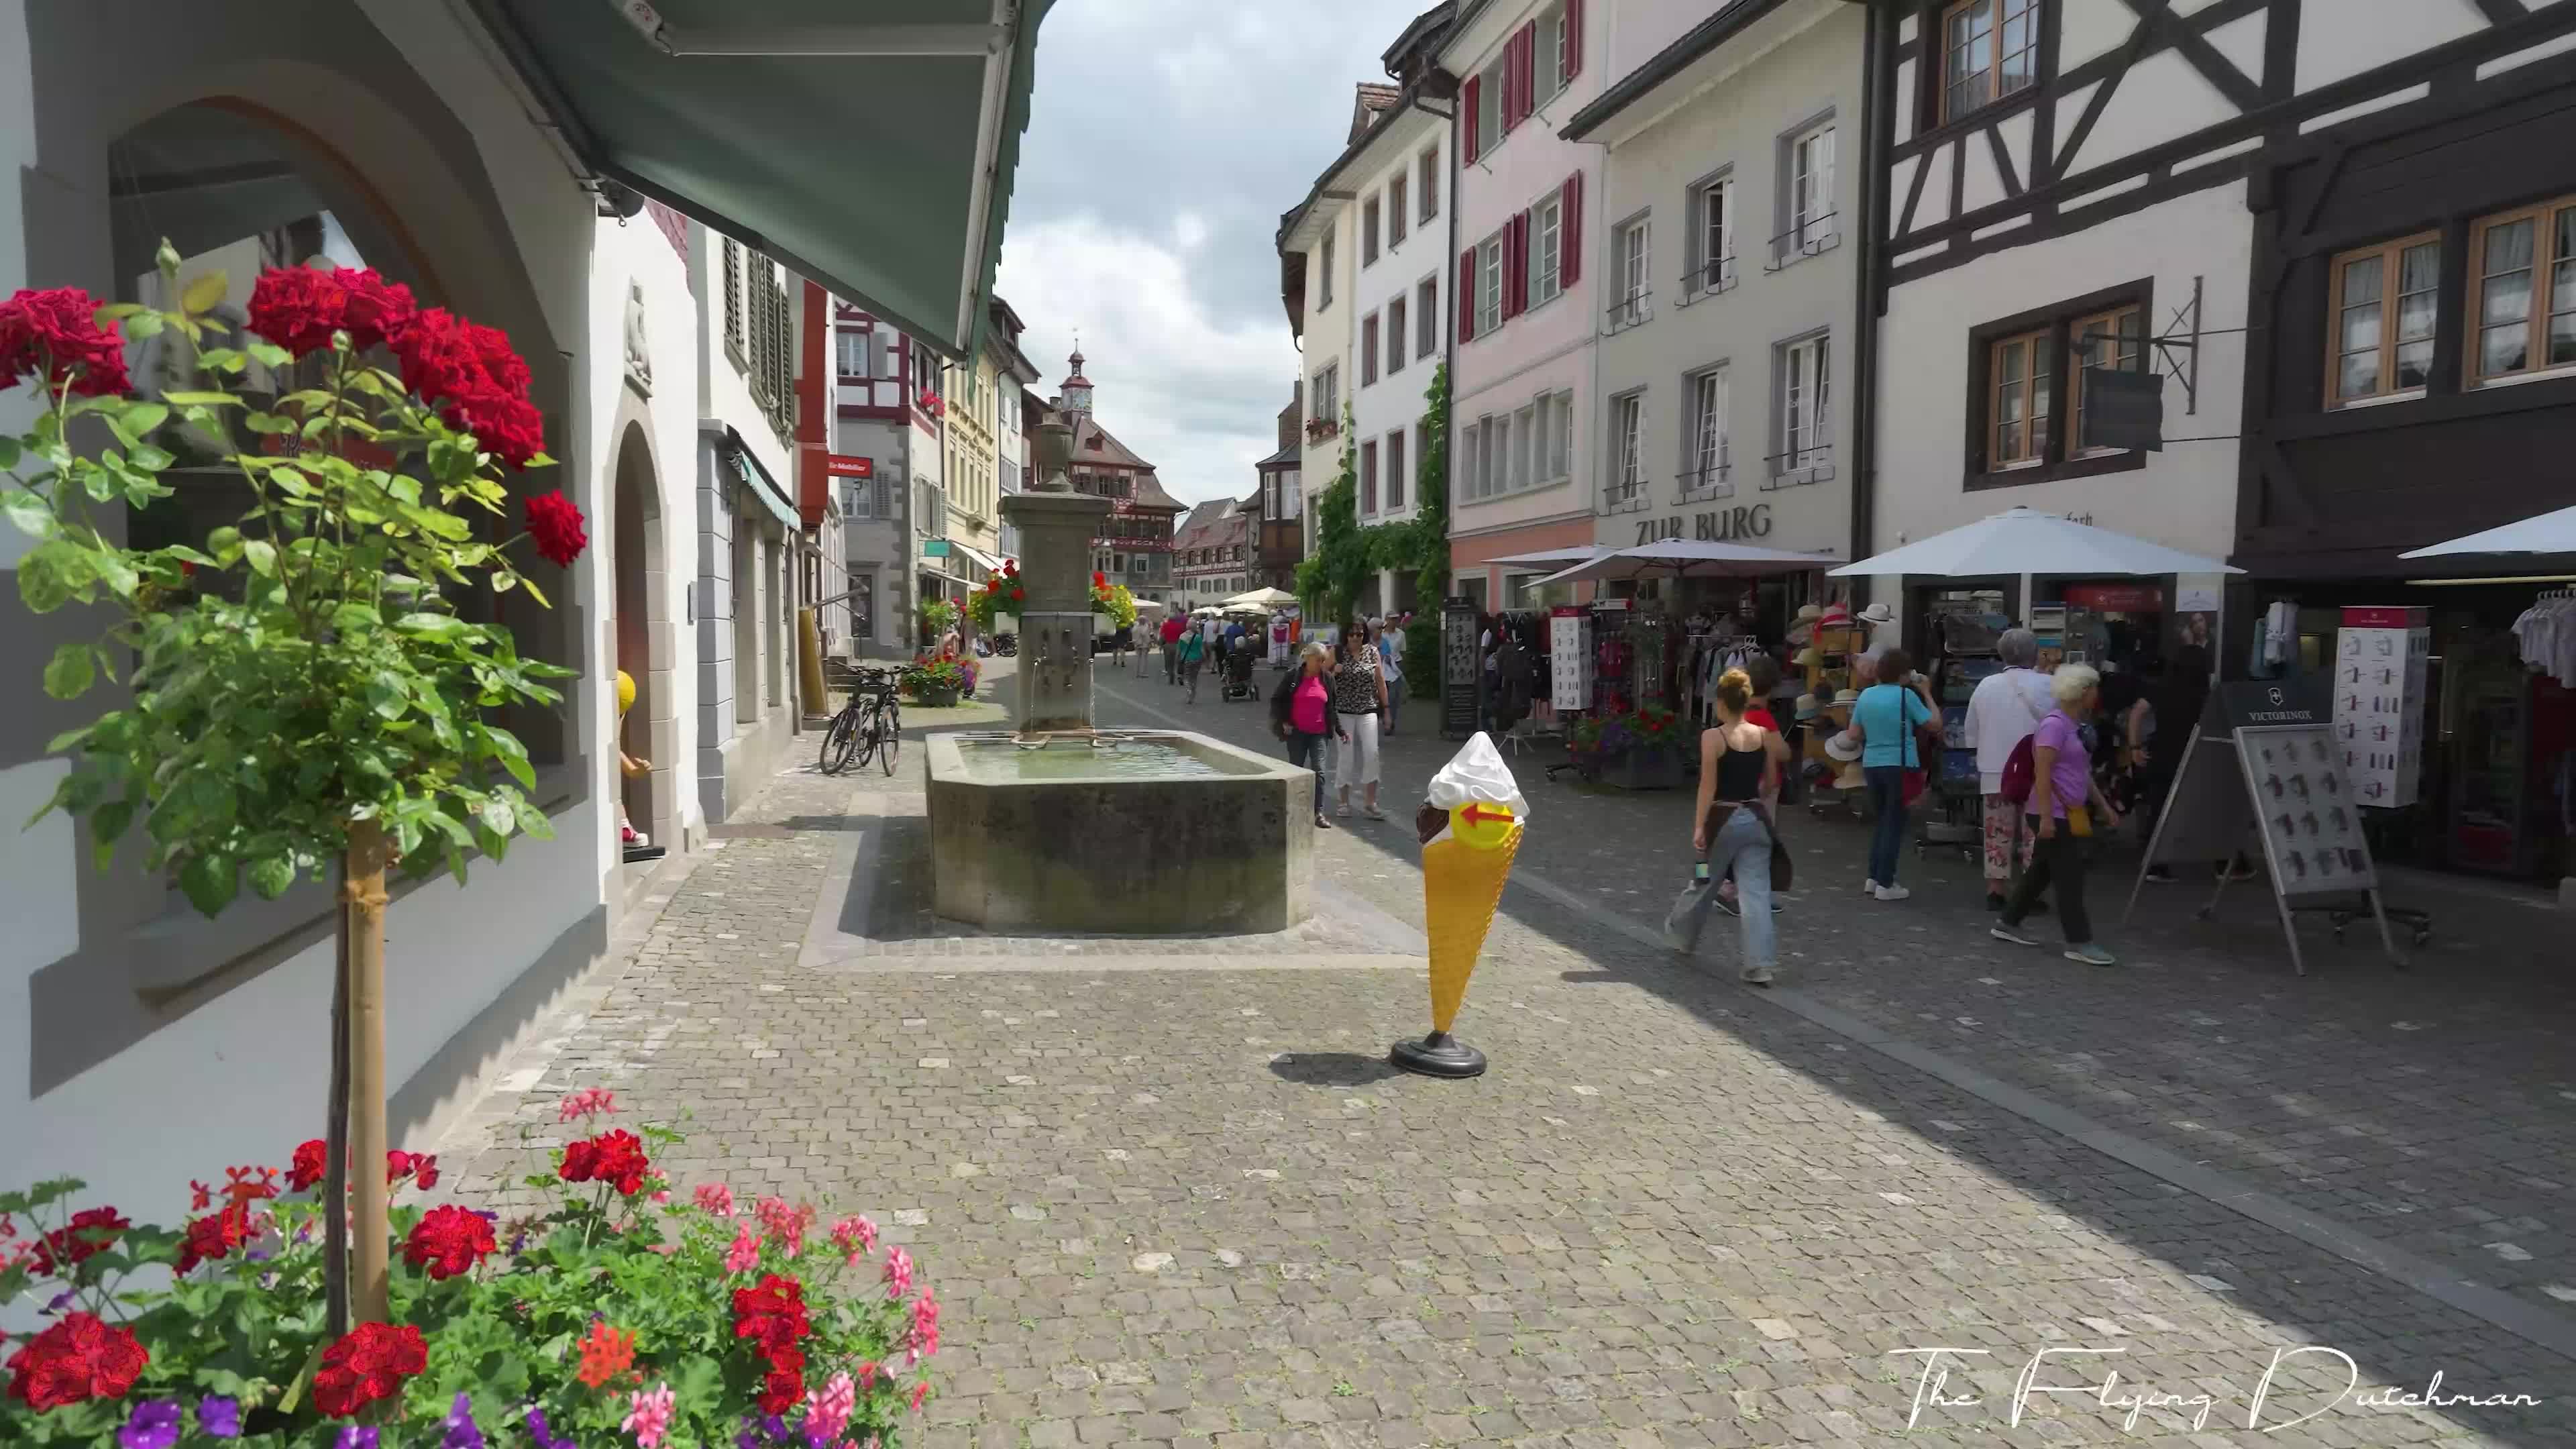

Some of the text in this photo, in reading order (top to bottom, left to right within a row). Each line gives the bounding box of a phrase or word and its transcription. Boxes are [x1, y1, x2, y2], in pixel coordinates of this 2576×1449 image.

[1635, 504, 1772, 546] ZUR BURG
[2248, 711, 2312, 720] VICTORINOX
